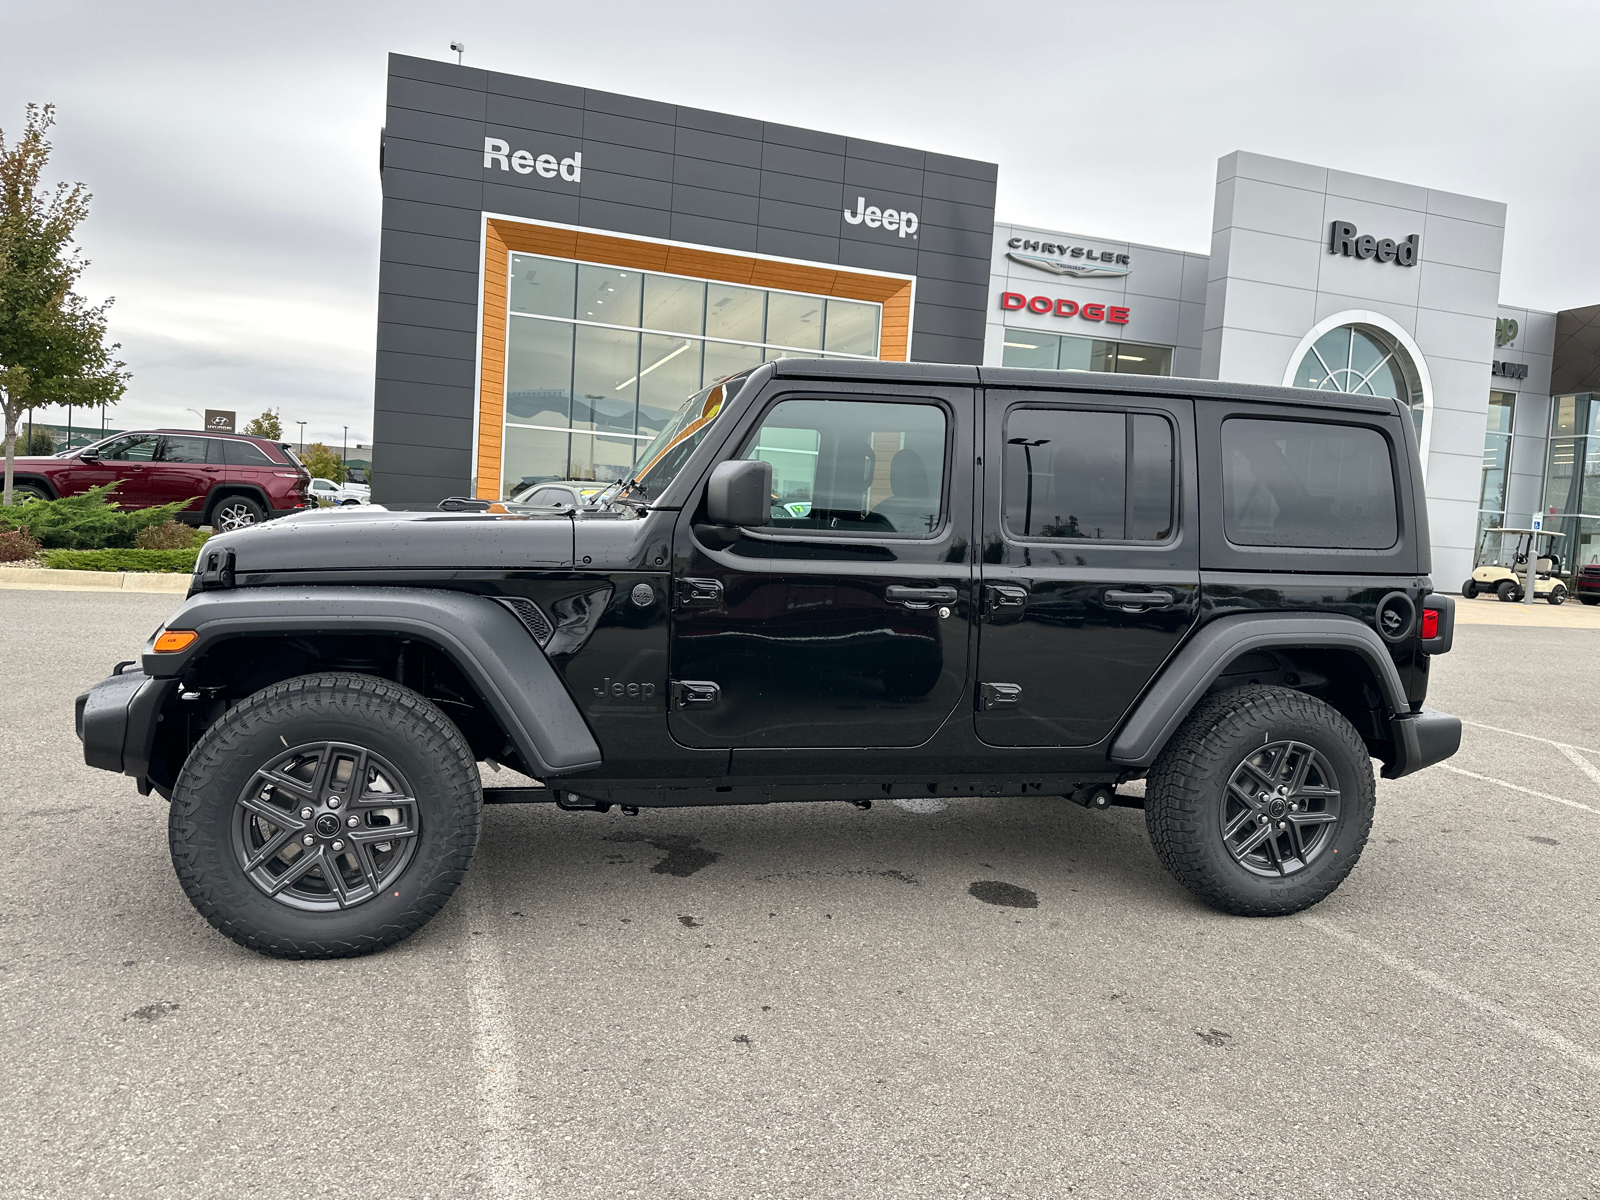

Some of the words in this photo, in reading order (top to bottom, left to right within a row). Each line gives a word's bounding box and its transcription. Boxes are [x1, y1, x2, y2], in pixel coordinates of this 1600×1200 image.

[484, 137, 582, 183] Reed
[844, 196, 919, 238] Jeep
[1008, 237, 1130, 265] CHRYSLER
[1329, 220, 1420, 267] Reed
[1001, 291, 1130, 324] DODGE
[1492, 360, 1528, 379] AM
[593, 677, 656, 702] Jeep
